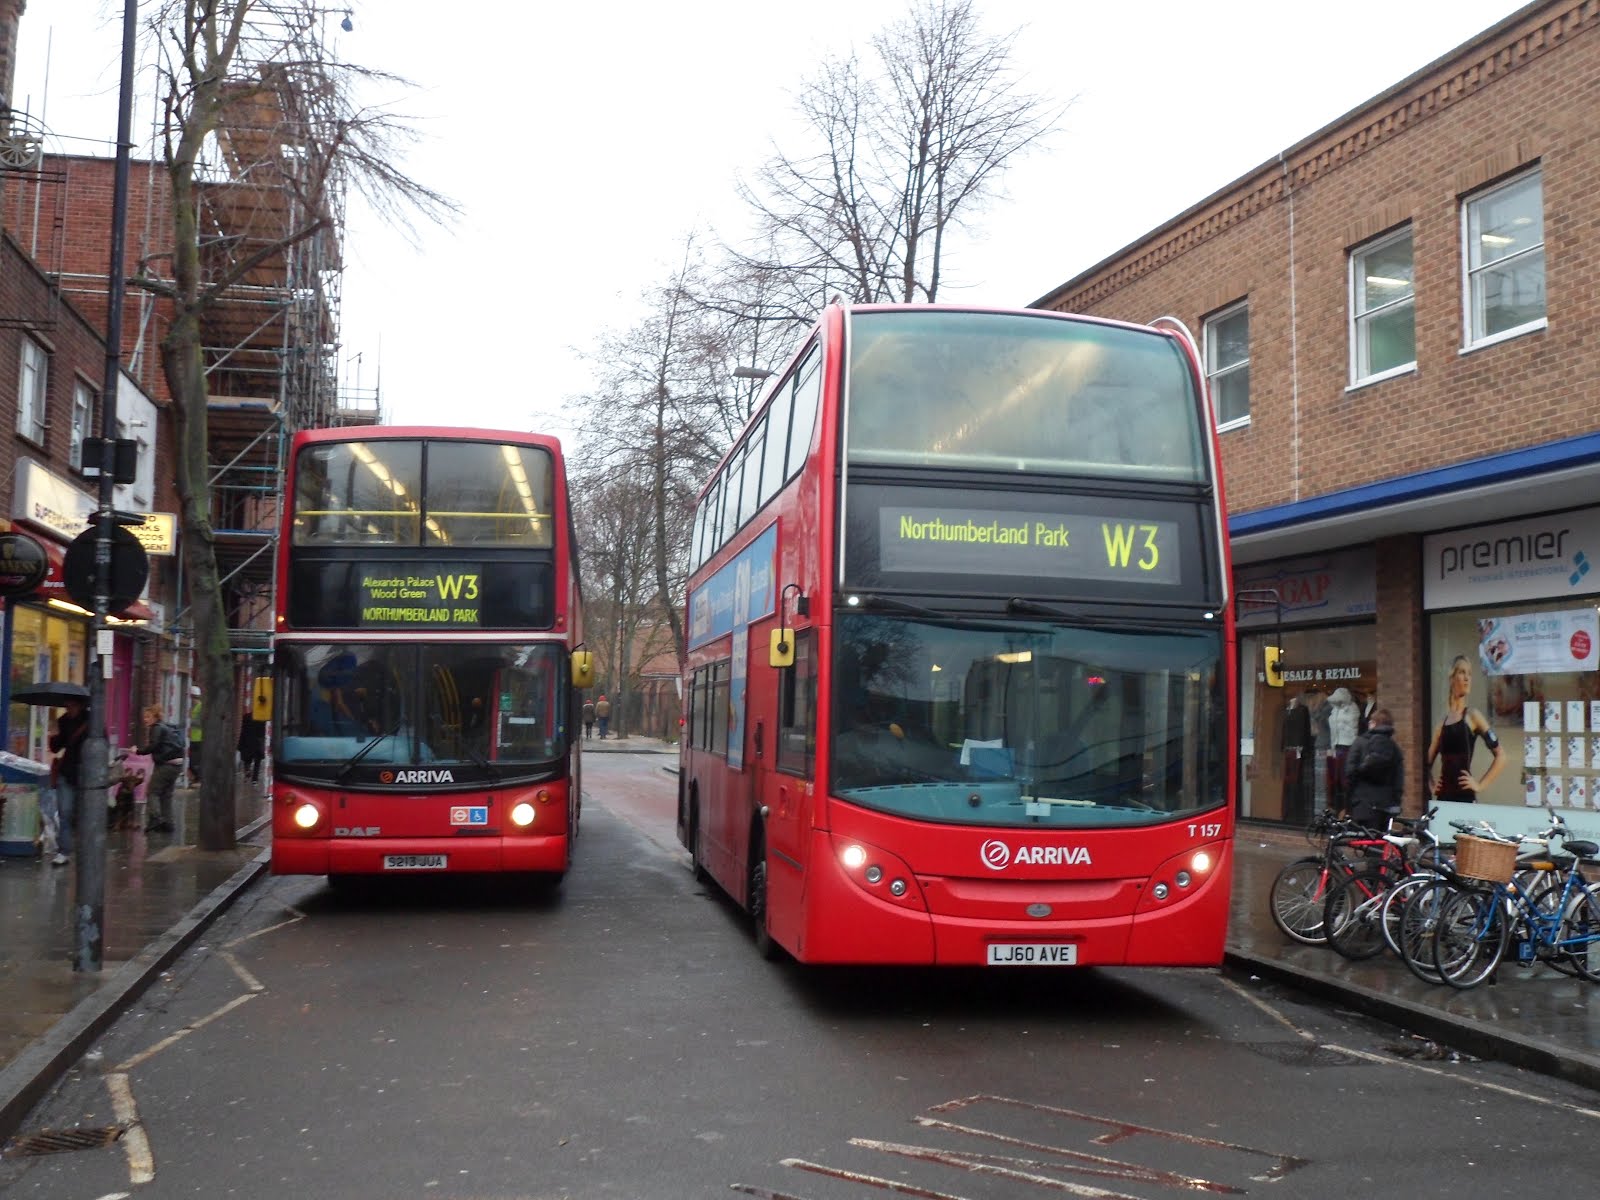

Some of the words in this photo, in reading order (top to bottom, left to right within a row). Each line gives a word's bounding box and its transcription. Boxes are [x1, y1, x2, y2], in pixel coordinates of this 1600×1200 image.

[899, 515, 1028, 545] Northumberland
[1035, 522, 1069, 547] Park
[1102, 523, 1160, 570] W3
[1440, 529, 1570, 580] premier
[362, 577, 405, 587] Alexandra
[407, 577, 435, 587] Palace
[436, 575, 479, 599] W3
[370, 588, 396, 598] Wood
[399, 588, 427, 598] Green
[362, 608, 450, 622] NORTHUMBERLAND
[453, 609, 479, 622] PARK
[1315, 669, 1323, 680] &
[1325, 667, 1362, 680] RETAIL
[395, 770, 455, 784] ARRIVA
[334, 826, 382, 837] DAF
[1187, 825, 1197, 837] T
[1200, 824, 1221, 837] 157
[1013, 847, 1092, 865] ARRIVA
[993, 946, 1034, 962] LJ60
[1039, 946, 1070, 962] AVE
